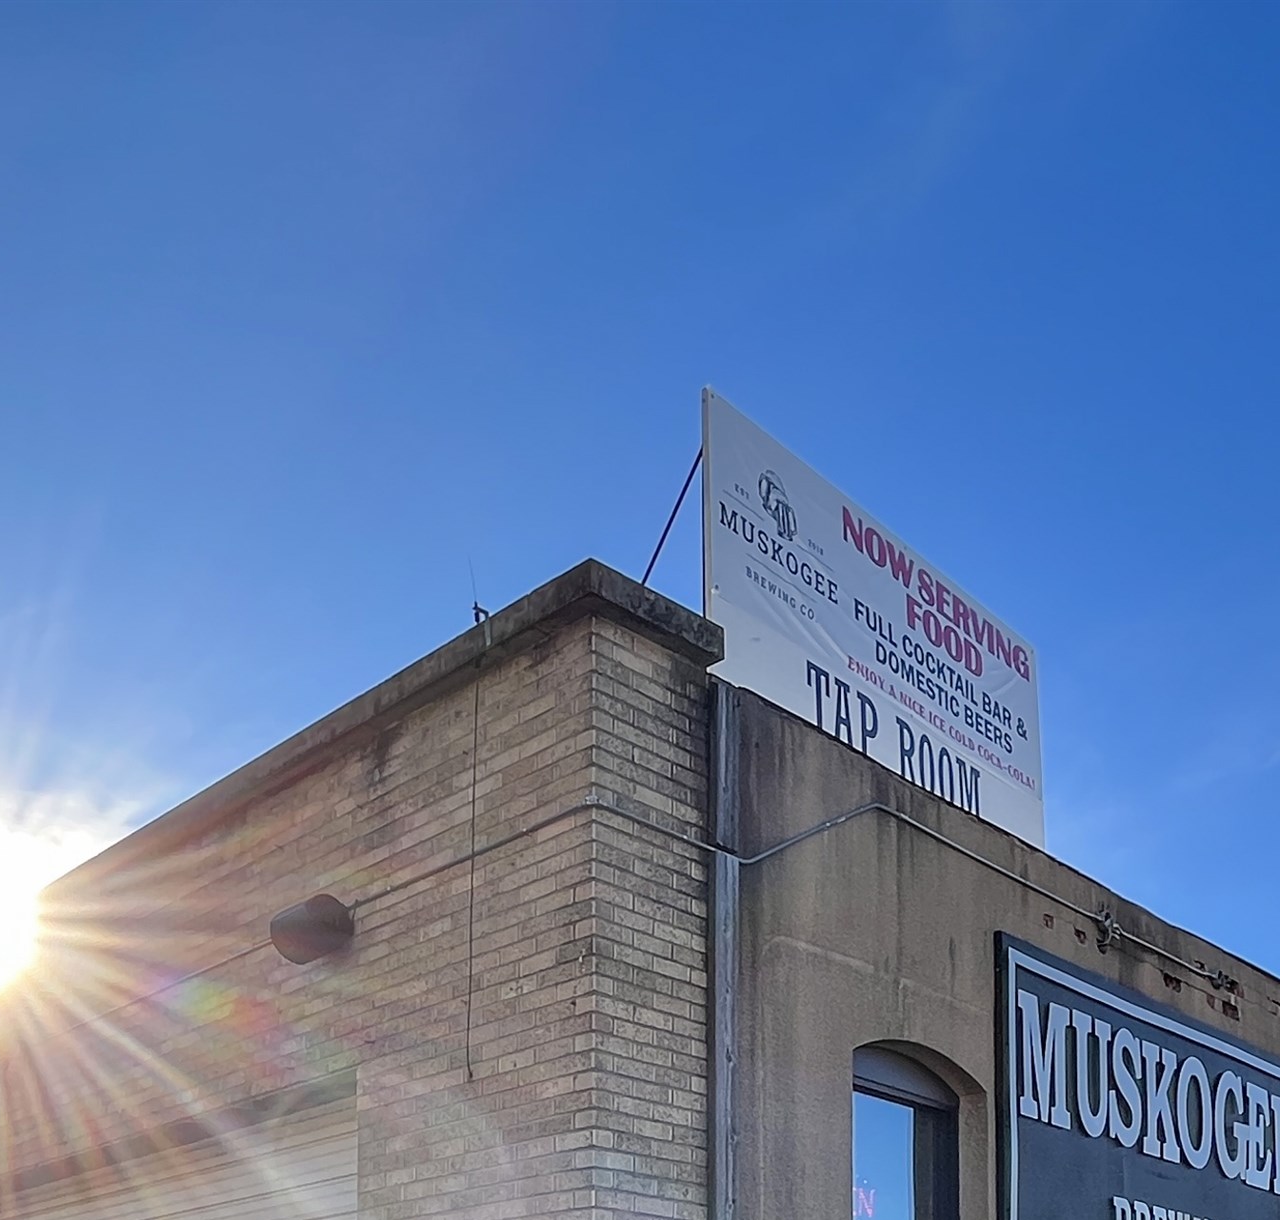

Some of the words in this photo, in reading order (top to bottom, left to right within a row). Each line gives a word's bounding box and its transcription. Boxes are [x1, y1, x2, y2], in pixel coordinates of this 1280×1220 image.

[719, 501, 839, 605] MUSKOGEE
[745, 565, 796, 609] BREWING
[842, 505, 915, 589] NOW
[917, 568, 1030, 682] SERVING
[854, 598, 898, 648] FULL
[902, 634, 978, 707] COCKTAIL
[982, 691, 1013, 730] BAR
[1016, 717, 1028, 741] &
[875, 639, 960, 718] DOMESTIC
[964, 704, 1014, 754] BEERS
[906, 593, 983, 677] FOOD
[806, 659, 879, 757] TAP
[895, 715, 981, 817] ROOM
[847, 655, 887, 692] ENJOY
[888, 684, 898, 700] A
[899, 691, 926, 719] NICE
[928, 711, 946, 734] ICE
[949, 725, 975, 751] COLD
[977, 744, 1036, 791] COCA-COLA!
